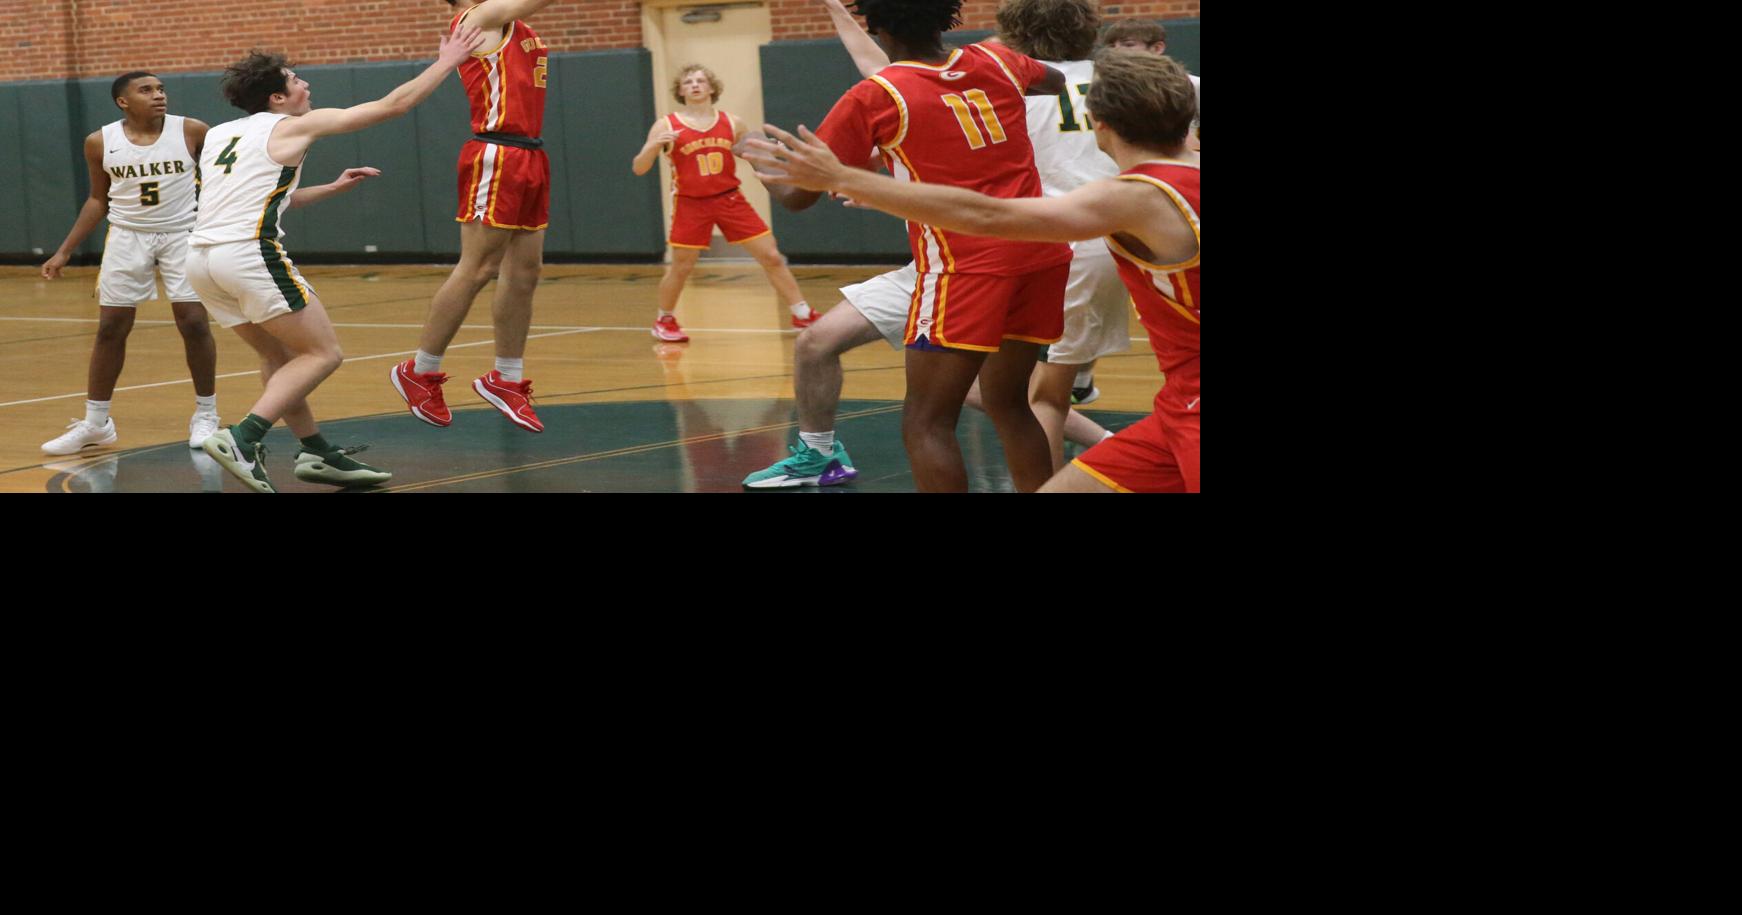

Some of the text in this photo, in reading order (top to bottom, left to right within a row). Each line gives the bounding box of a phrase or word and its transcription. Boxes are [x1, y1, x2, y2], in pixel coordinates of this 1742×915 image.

[941, 88, 1007, 150] 11
[213, 135, 243, 175] 4
[696, 152, 724, 176] 10
[110, 160, 185, 178] WALKER
[139, 181, 160, 206] 5
